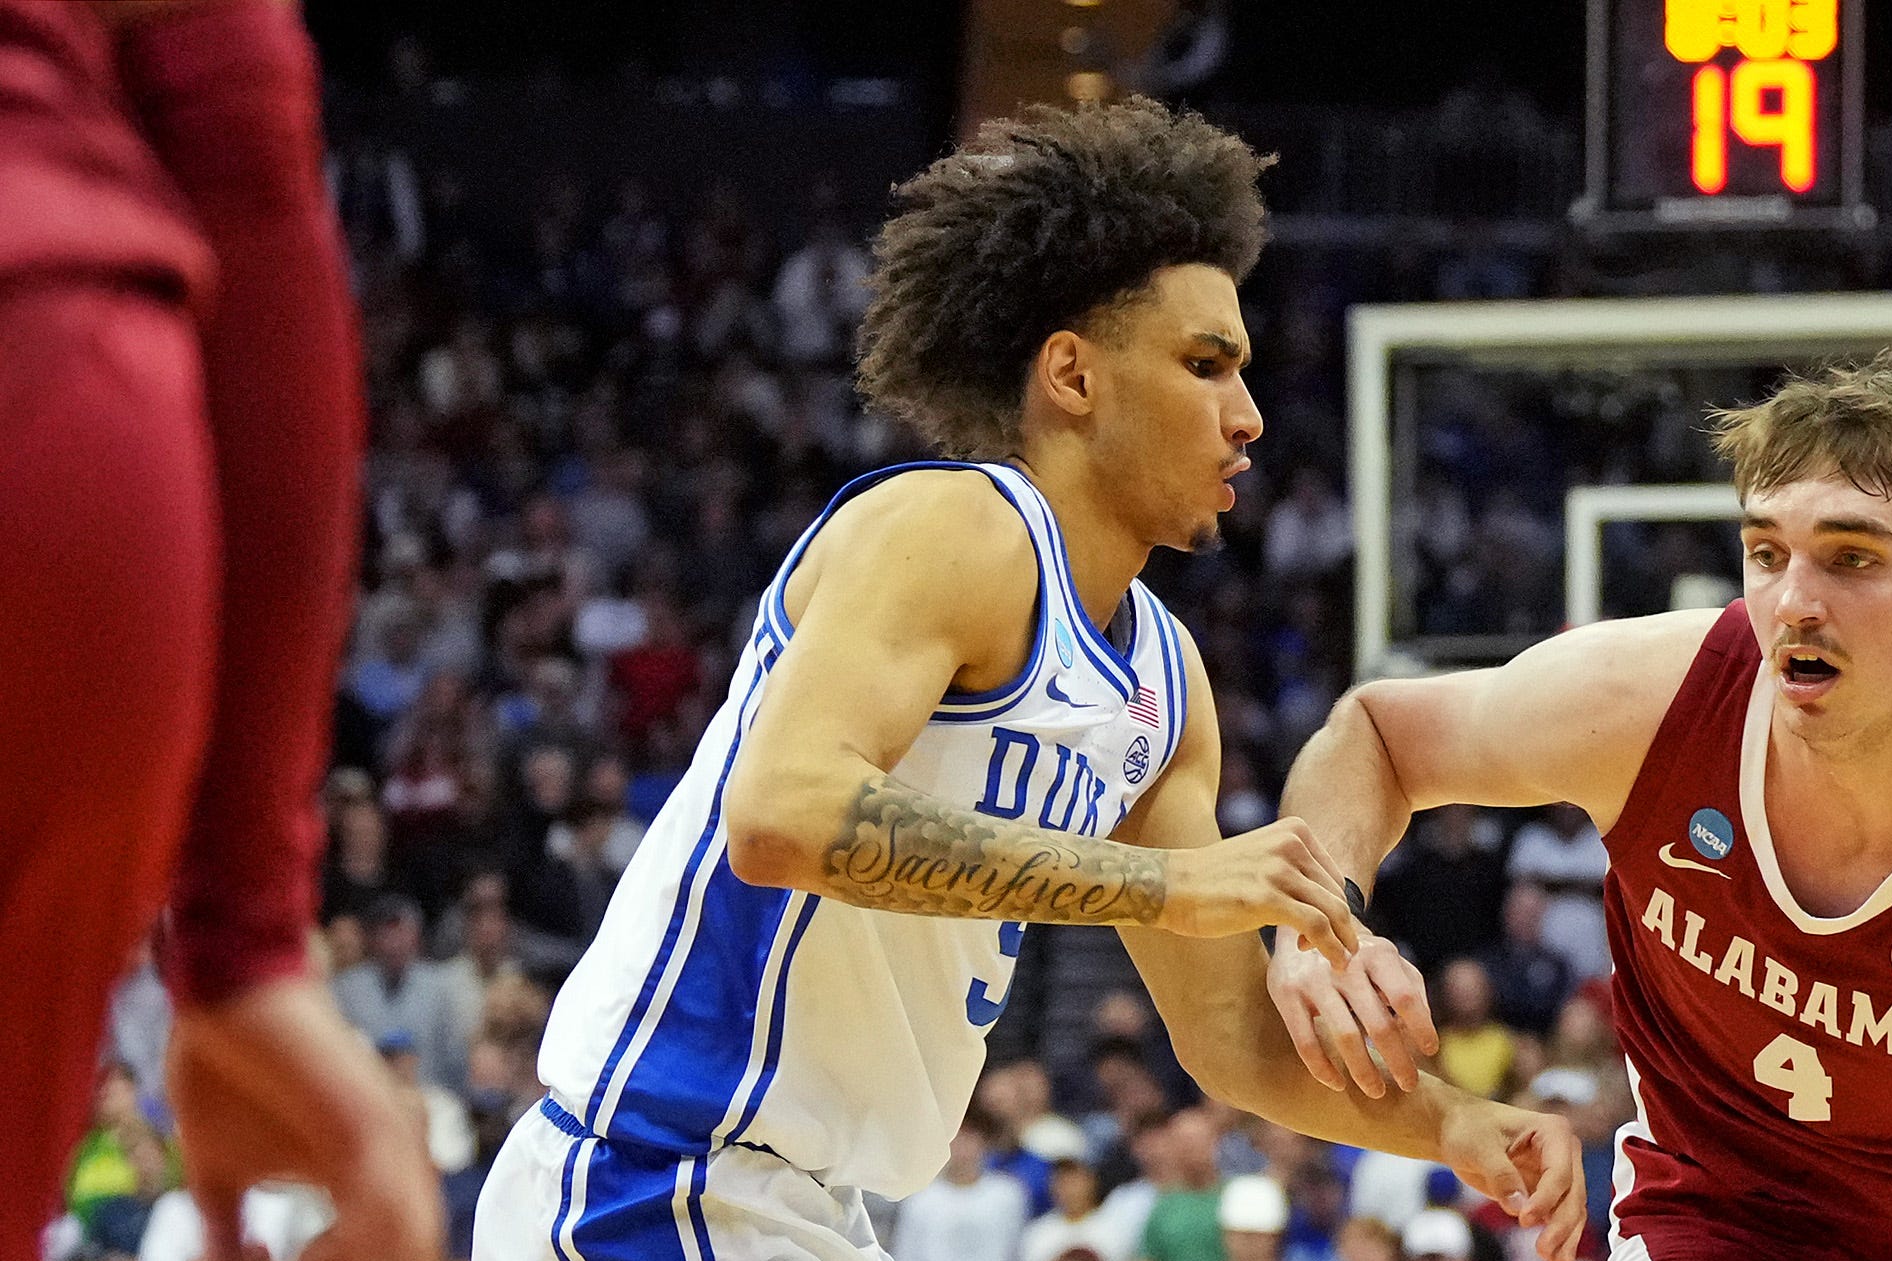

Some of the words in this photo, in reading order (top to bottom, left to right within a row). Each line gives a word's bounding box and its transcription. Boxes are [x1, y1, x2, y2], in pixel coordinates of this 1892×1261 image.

[1692, 59, 1817, 194] 19
[974, 726, 1128, 837] DUK
[1126, 750, 1149, 769] ACC
[847, 823, 1127, 915] Sacrifice
[1692, 823, 1727, 856] NCAA
[1753, 1033, 1832, 1121] 4
